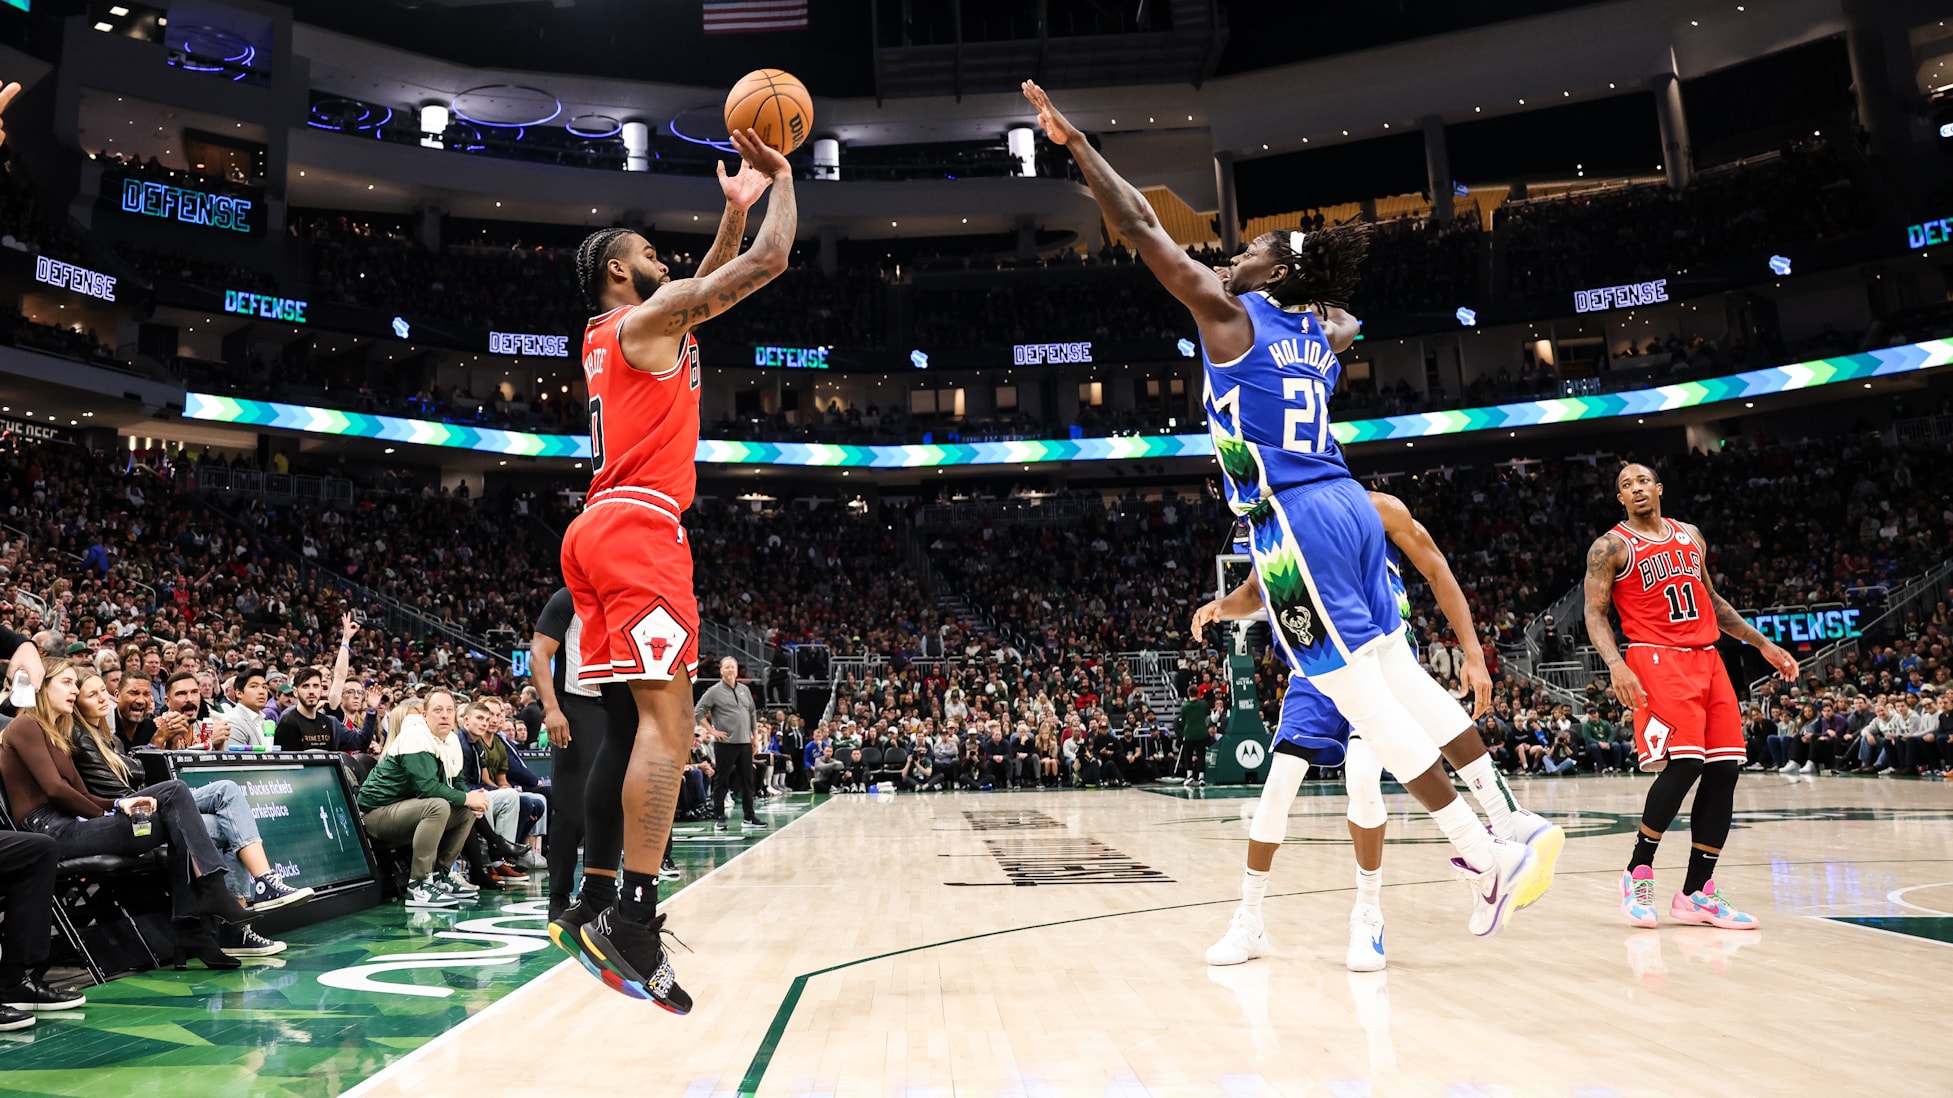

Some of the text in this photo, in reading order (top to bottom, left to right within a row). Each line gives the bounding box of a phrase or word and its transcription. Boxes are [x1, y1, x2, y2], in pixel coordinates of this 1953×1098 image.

[122, 178, 251, 232] DEFENSE
[36, 255, 116, 302] DEFENSE
[225, 290, 307, 323] DEFENSE
[1574, 279, 1668, 313] DEFENSE
[489, 331, 568, 357] DEFENSE
[755, 346, 829, 369] DEFENSE
[1013, 342, 1092, 365] DEFENSE
[1268, 338, 1336, 376] HOLIDAY
[1282, 378, 1328, 453] 21
[1638, 550, 1701, 591] BULLS
[1664, 582, 1699, 623] 11
[248, 780, 269, 795] Bucks
[270, 779, 293, 794] tickets
[252, 802, 289, 820] arketplace
